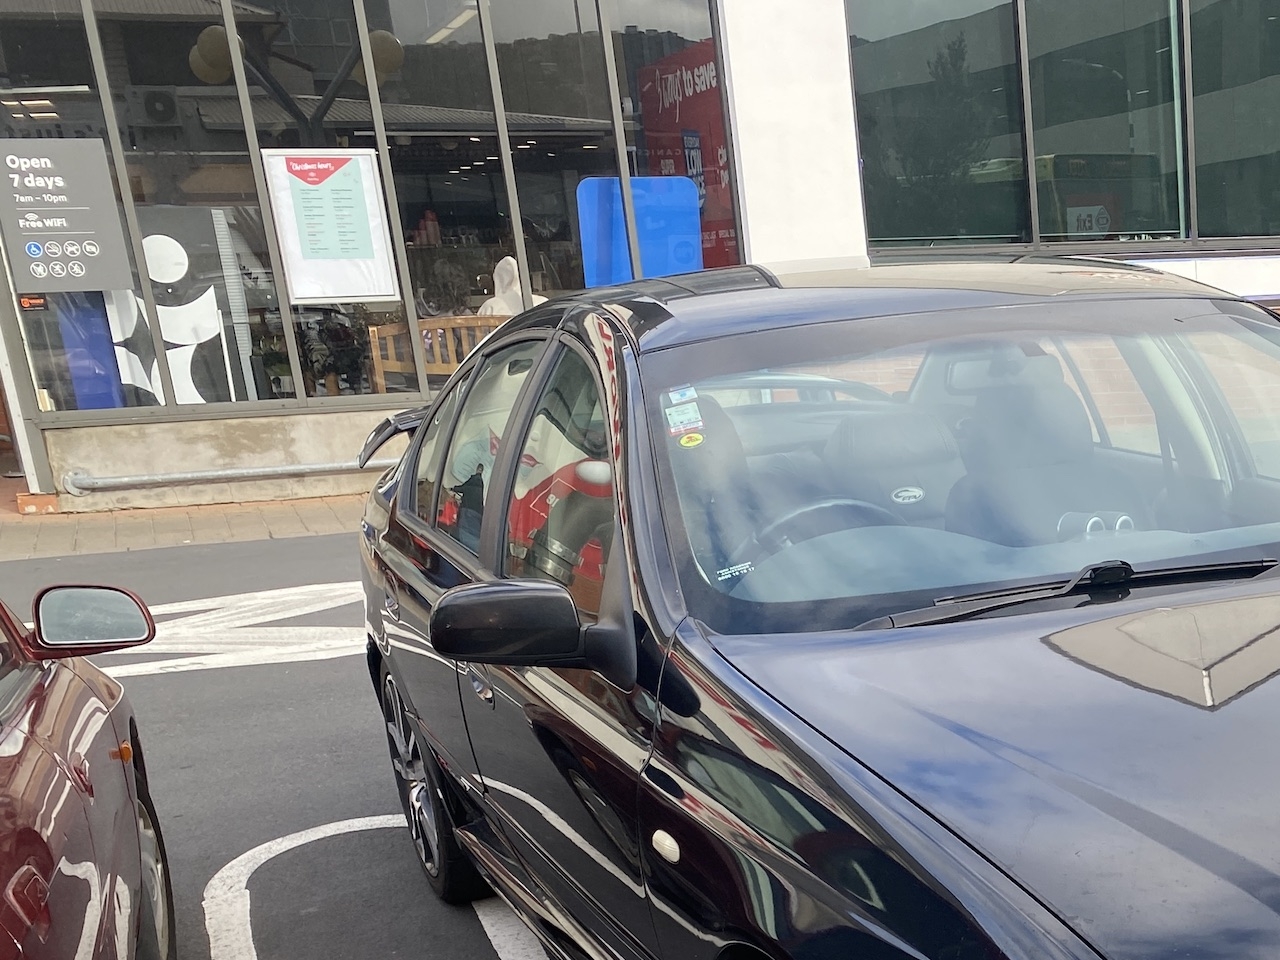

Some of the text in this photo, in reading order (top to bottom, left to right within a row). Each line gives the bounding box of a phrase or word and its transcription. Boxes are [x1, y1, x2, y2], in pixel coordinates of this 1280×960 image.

[682, 66, 694, 97] to
[694, 61, 717, 93] save
[5, 155, 52, 172] Open
[684, 149, 703, 175] LOW
[8, 173, 65, 190] 7 days
[13, 194, 34, 203] 7am
[42, 194, 67, 204] 10pm
[19, 219, 42, 229] Free
